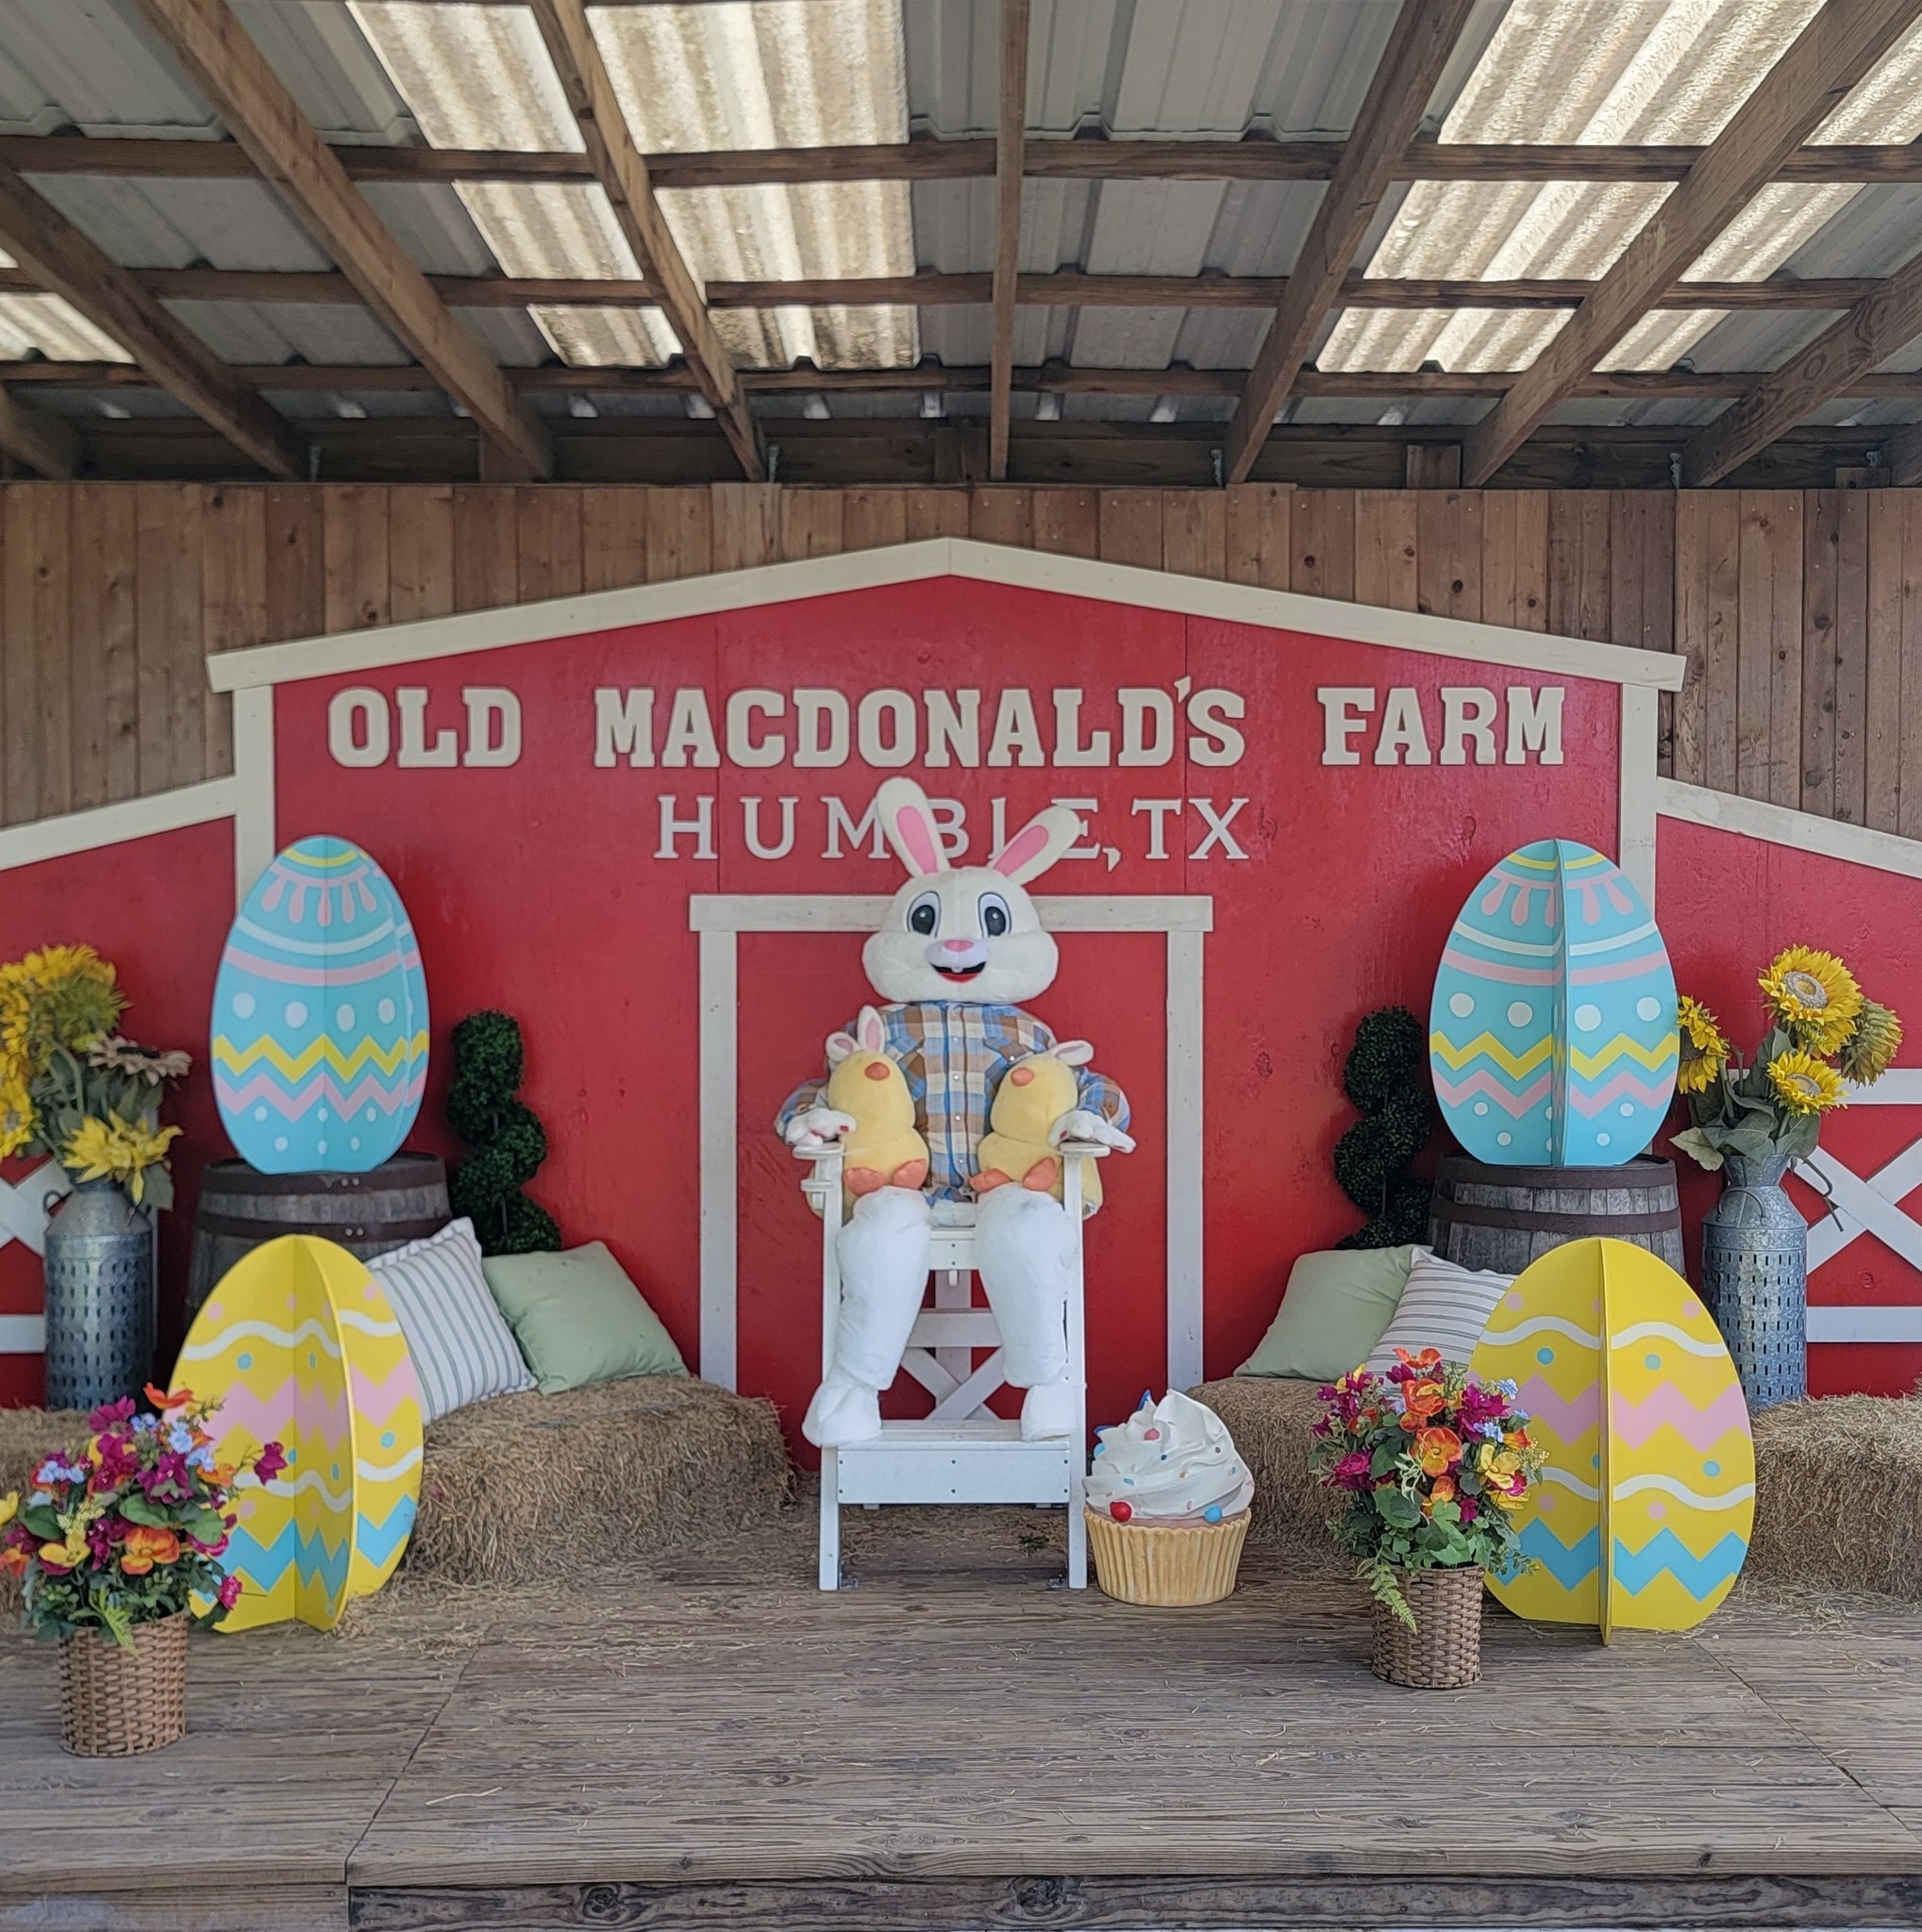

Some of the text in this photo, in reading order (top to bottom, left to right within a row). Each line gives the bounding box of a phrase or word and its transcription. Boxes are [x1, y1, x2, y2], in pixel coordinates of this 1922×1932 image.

[328, 675, 1566, 769] OLD MACDONALD'S FARM
